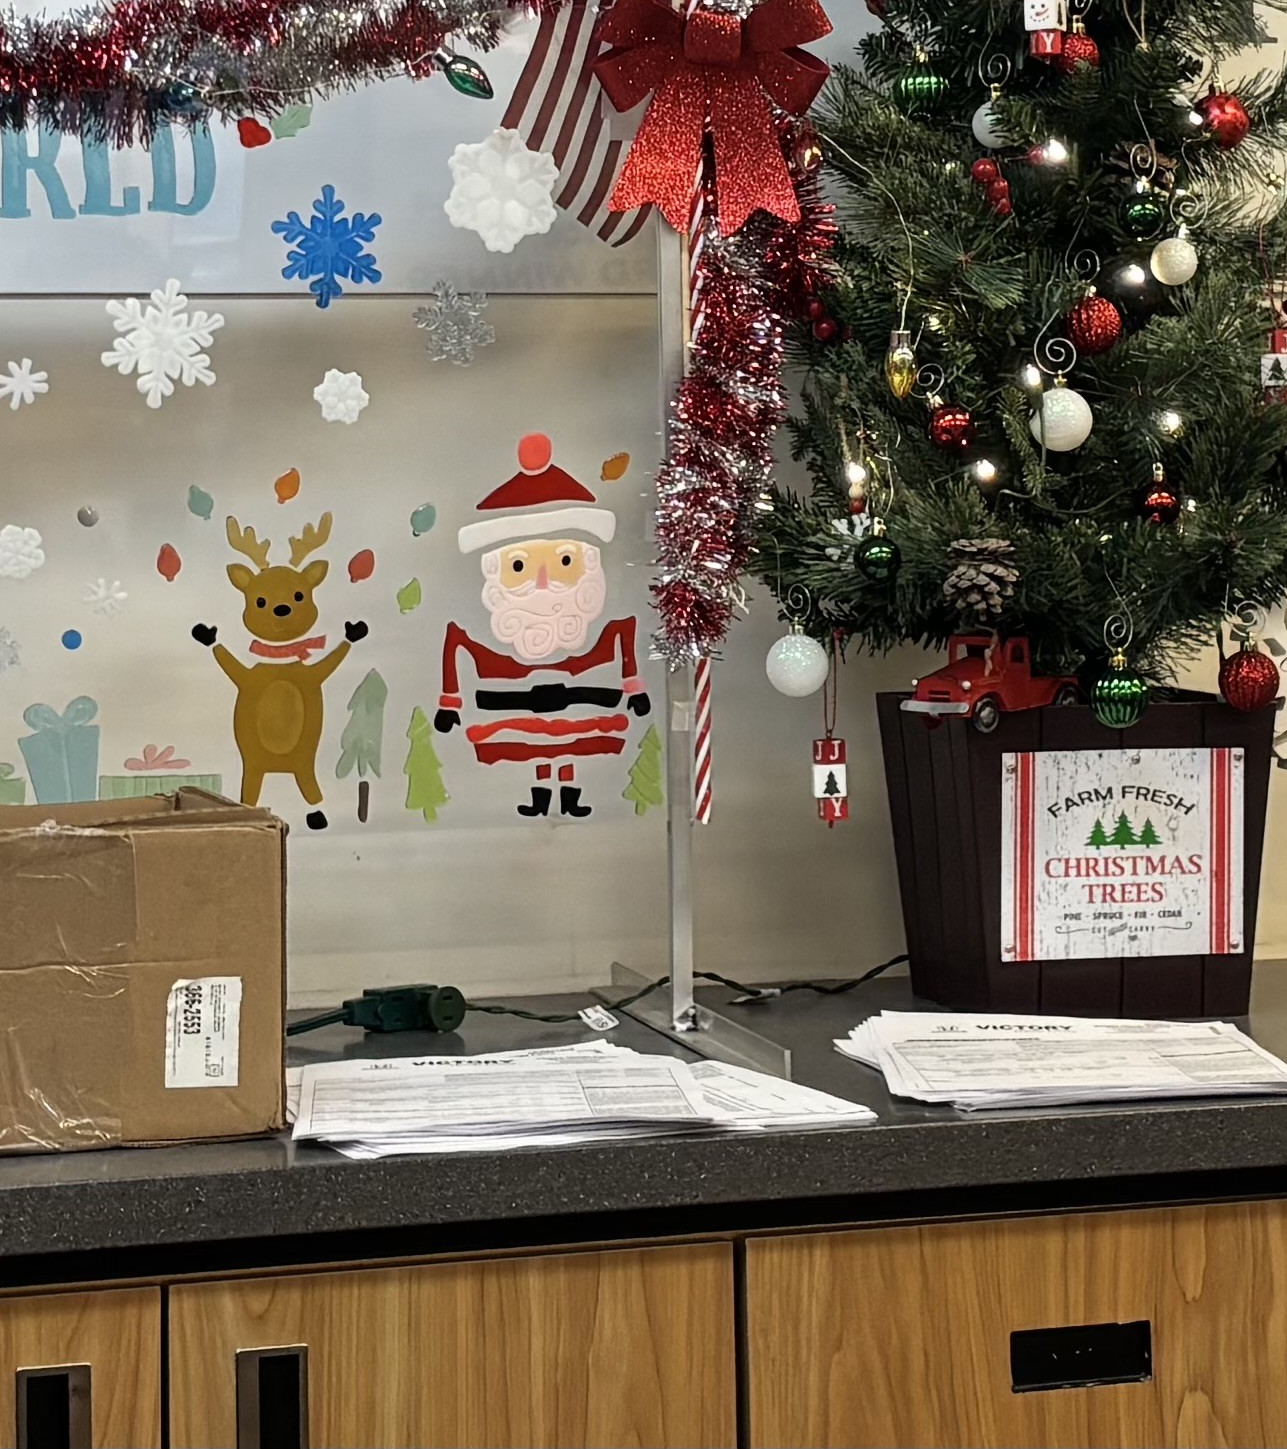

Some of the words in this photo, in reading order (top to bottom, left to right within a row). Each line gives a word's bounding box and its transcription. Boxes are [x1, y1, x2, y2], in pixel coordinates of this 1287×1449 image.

[1047, 786, 1113, 819] FARM
[1121, 784, 1196, 816] FRESH
[1044, 854, 1204, 879] CHRISTMAS
[1081, 882, 1164, 905] TREES
